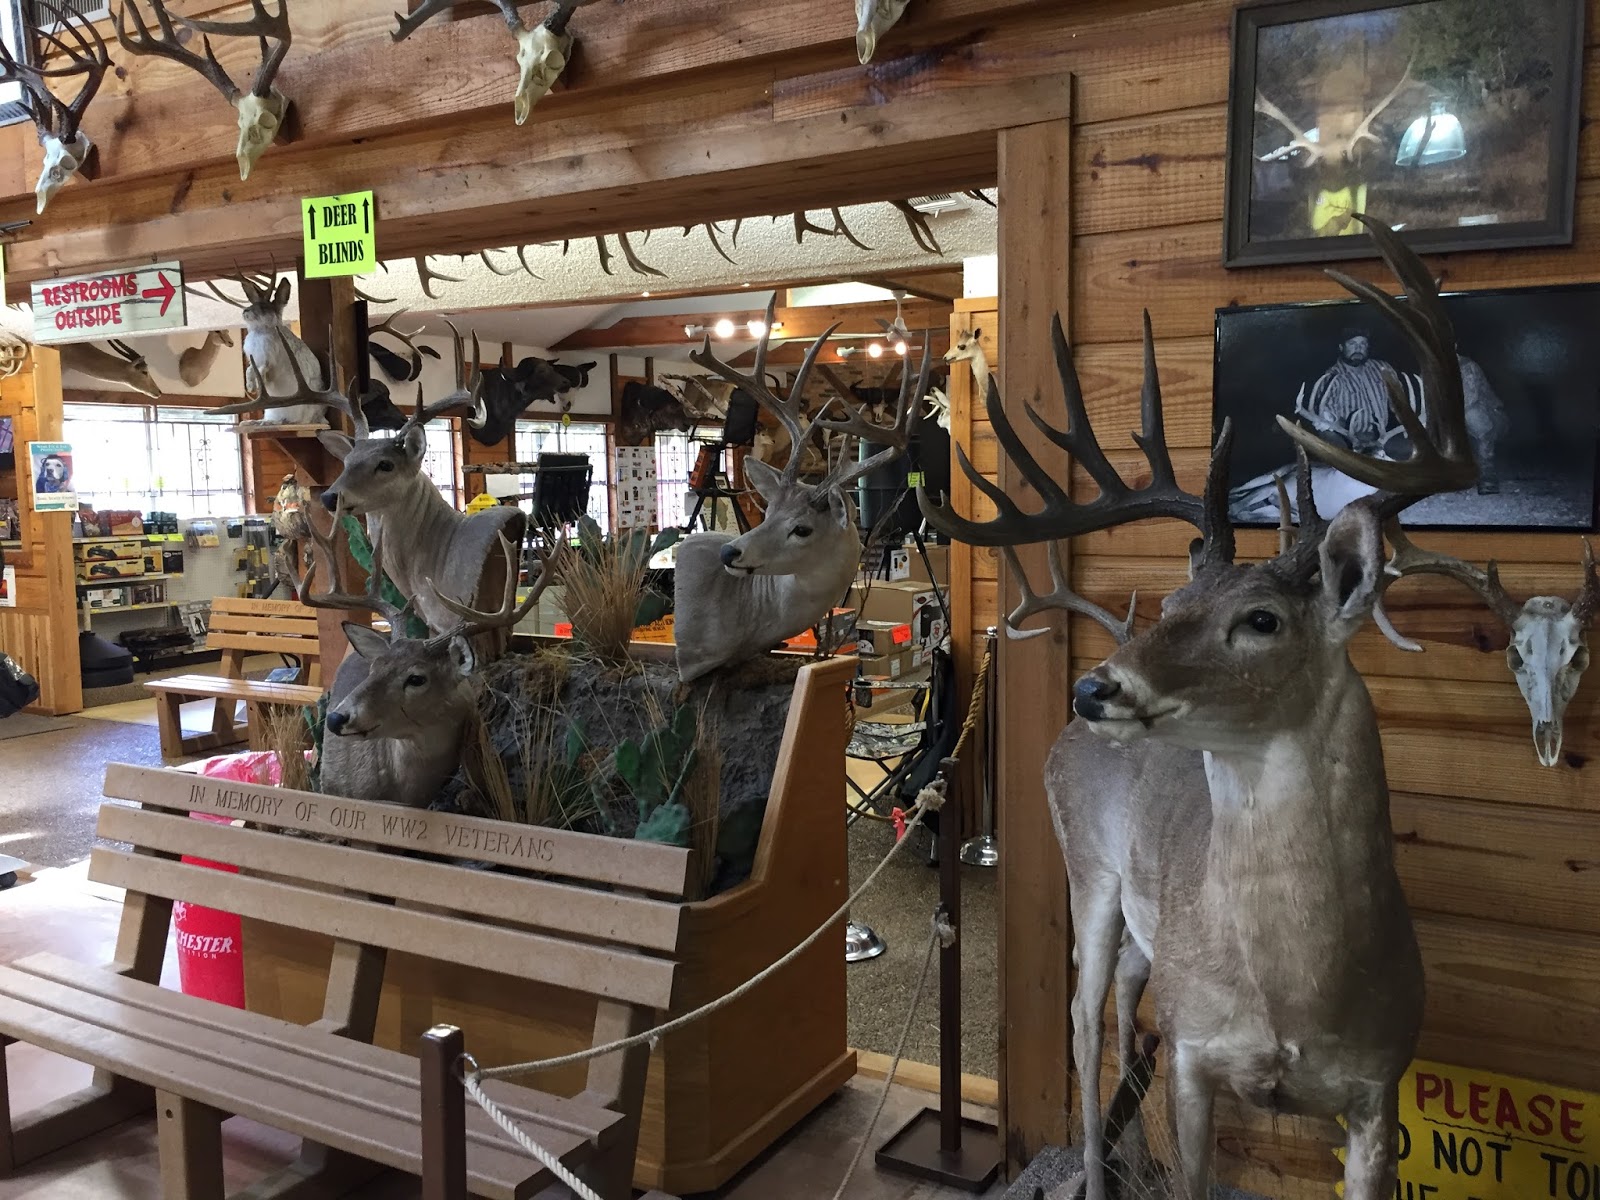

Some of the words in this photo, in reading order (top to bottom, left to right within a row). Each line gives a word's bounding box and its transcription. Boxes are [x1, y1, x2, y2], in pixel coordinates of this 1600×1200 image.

[323, 203, 357, 228] DEER
[318, 239, 364, 265] BLINDS
[42, 273, 138, 306] RESTROOMS
[55, 303, 122, 330] OUTSIDE
[262, 603, 291, 613] MEMORY
[189, 784, 206, 803] IN
[214, 788, 283, 817] MEMORY
[295, 801, 318, 822] OF
[330, 806, 366, 830] OUR
[382, 814, 428, 841] WW2
[445, 824, 555, 862] VETERANS
[1416, 1072, 1586, 1144] PLEASE
[1433, 1129, 1512, 1183] NOT
